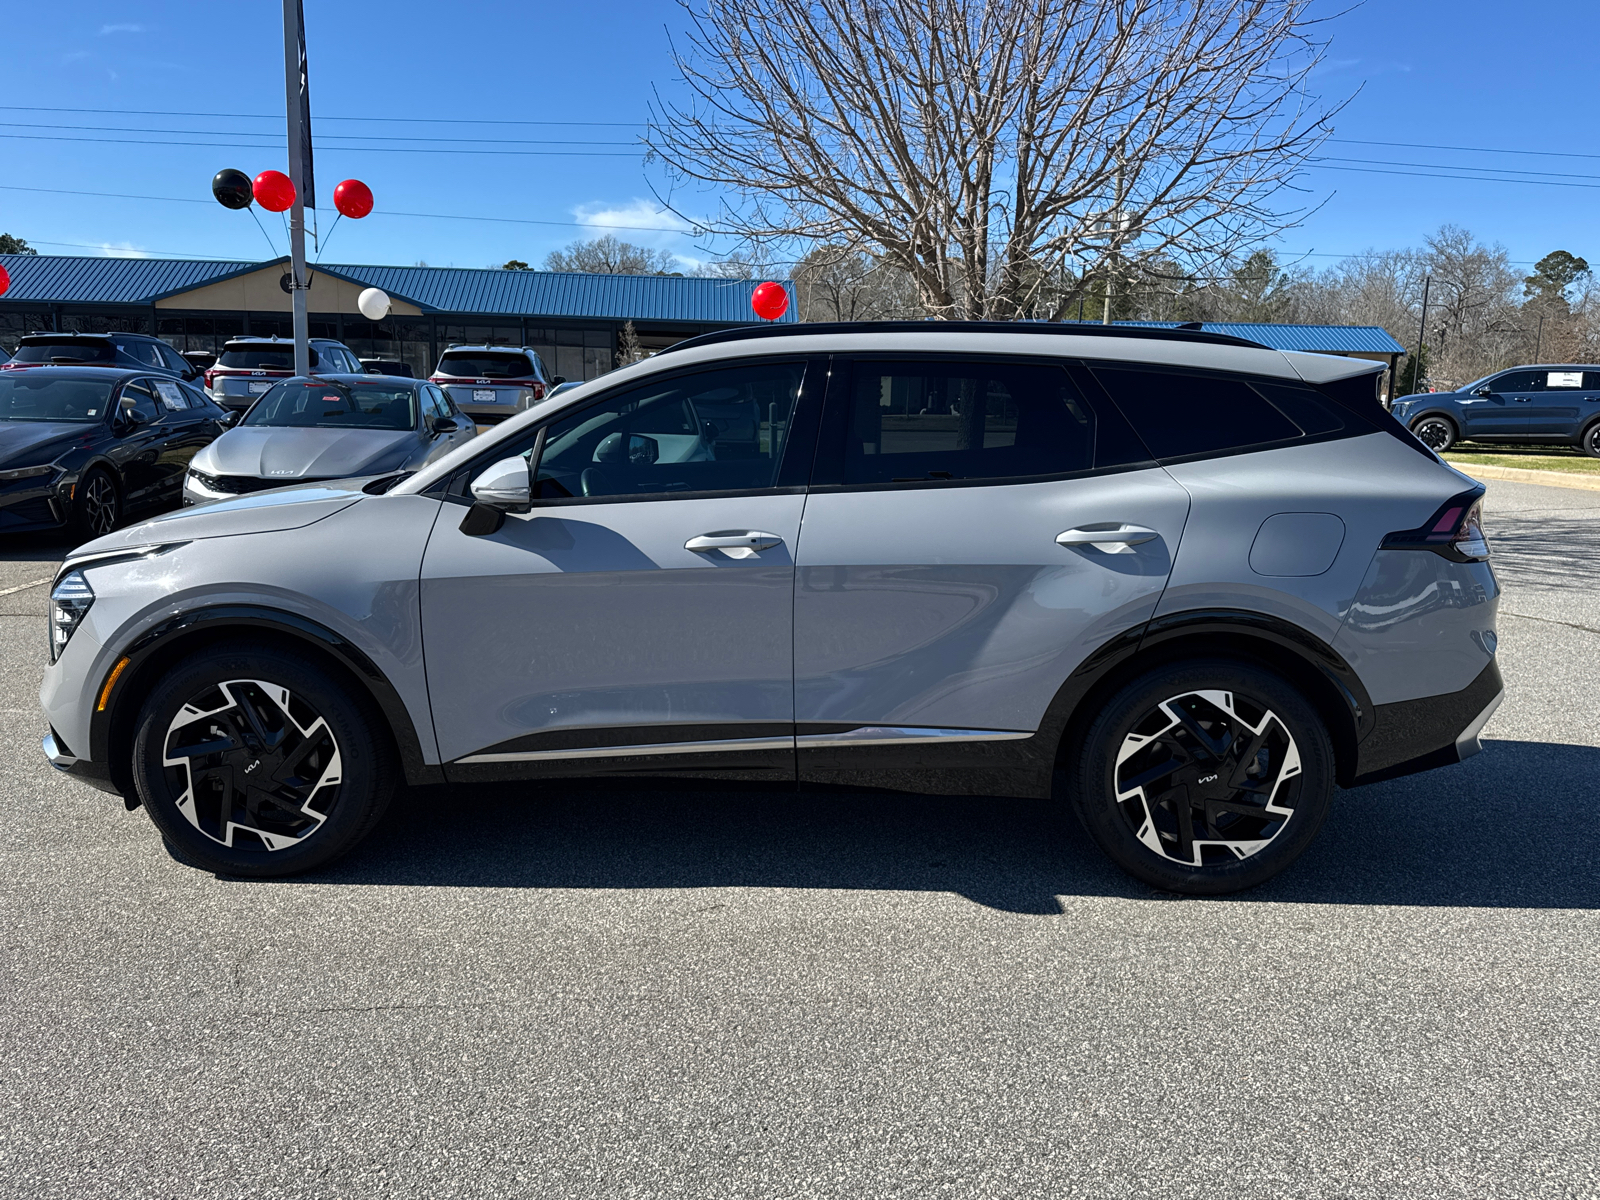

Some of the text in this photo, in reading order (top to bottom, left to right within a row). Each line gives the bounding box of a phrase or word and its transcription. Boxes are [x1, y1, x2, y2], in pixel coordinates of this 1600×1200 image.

[328, 703, 360, 760] KUMHO
[1106, 689, 1152, 737] KUMHO
[243, 759, 261, 774] KIA
[1197, 773, 1218, 784] KIA
[1305, 727, 1324, 790] CRUGEN
